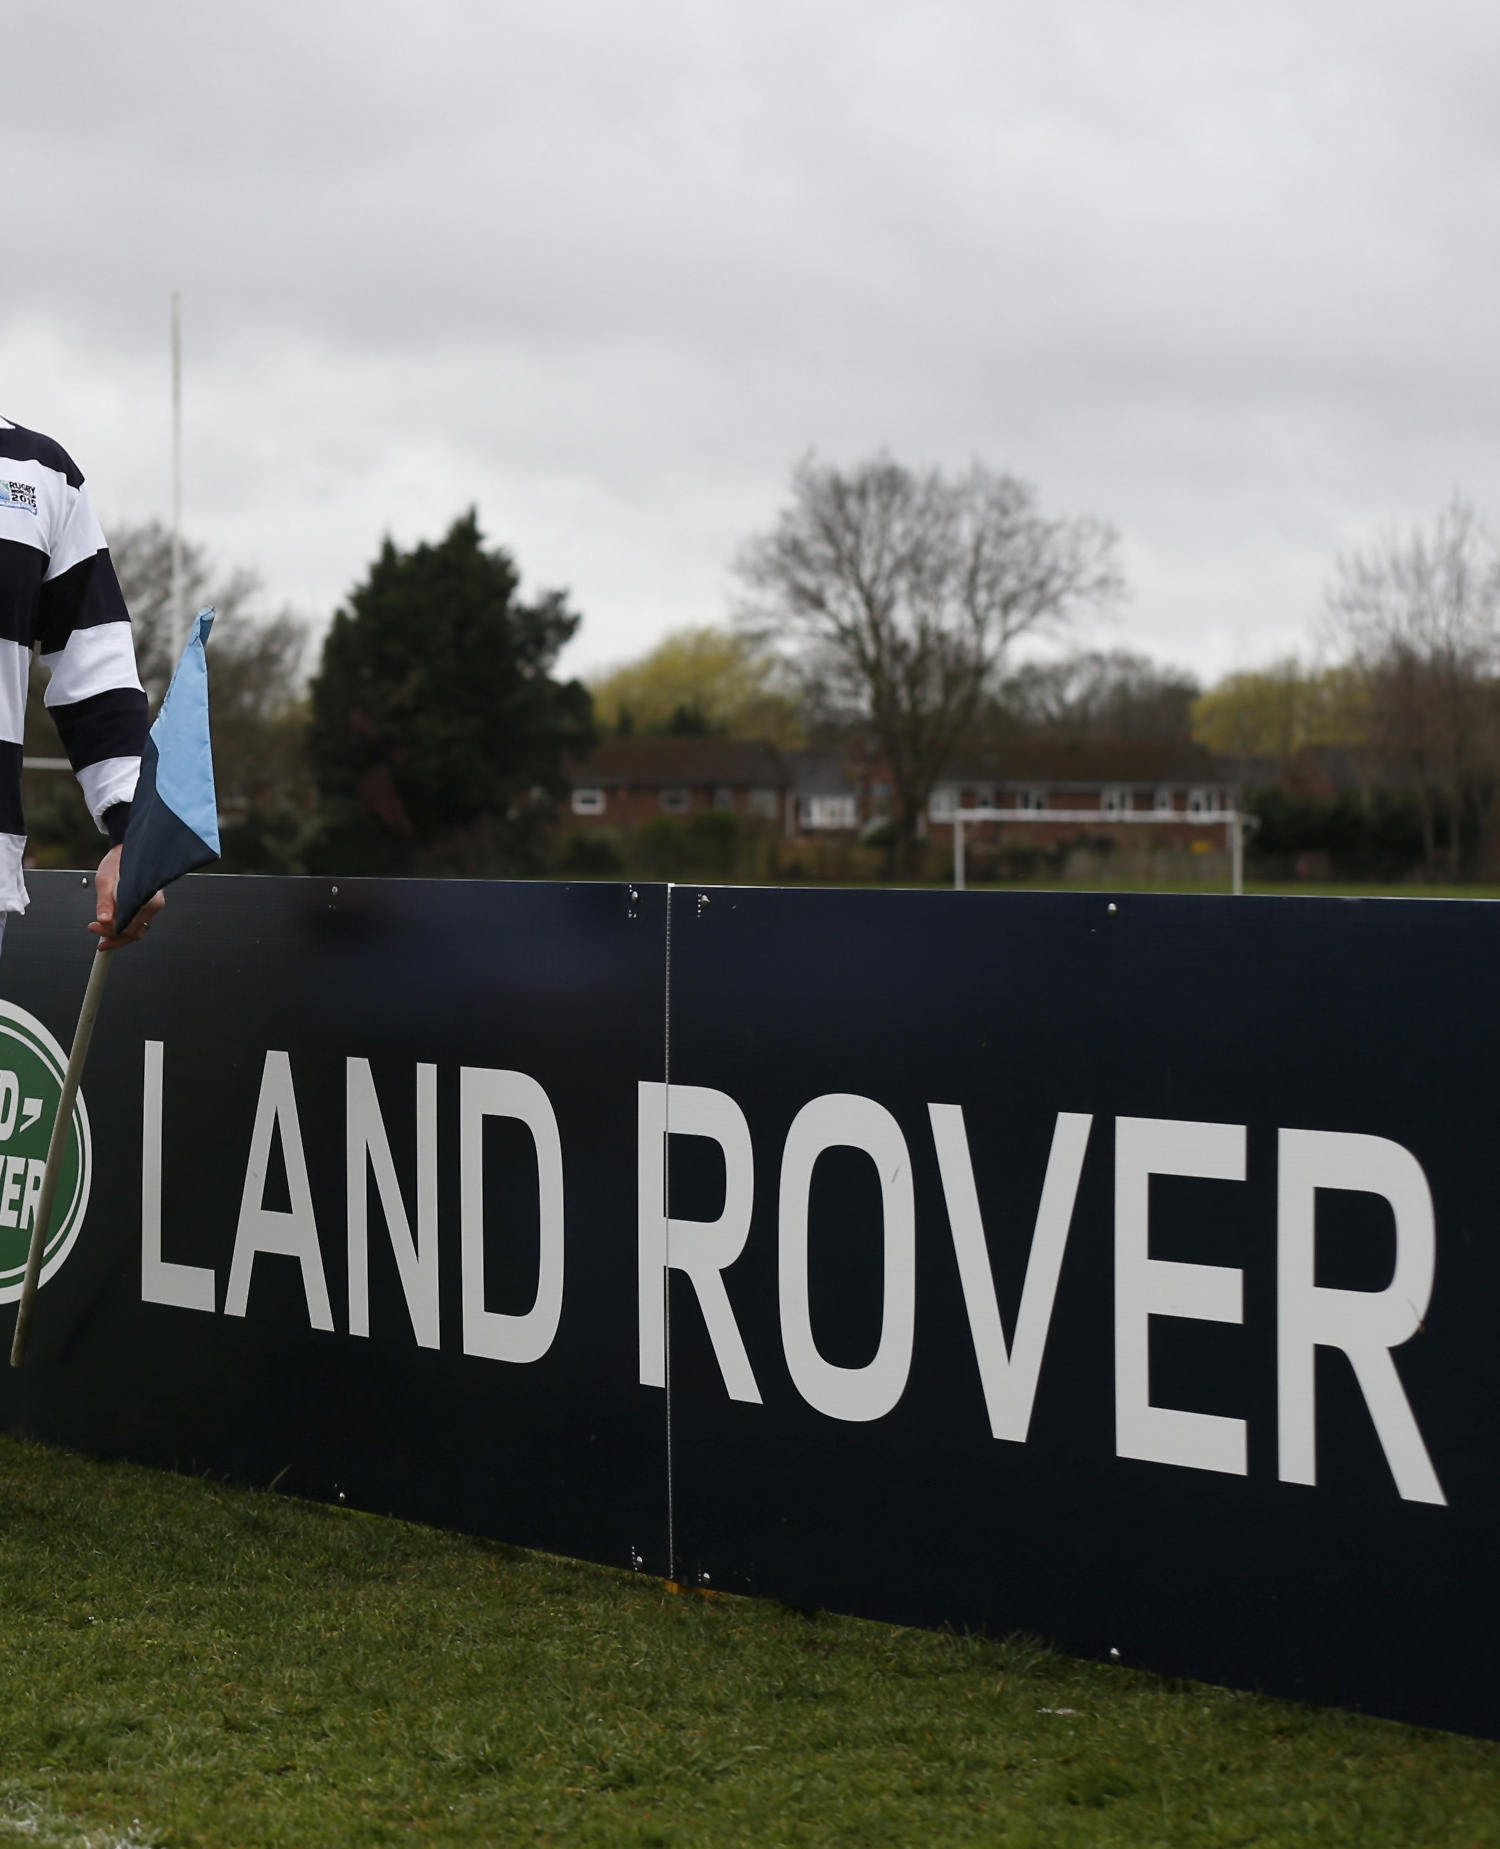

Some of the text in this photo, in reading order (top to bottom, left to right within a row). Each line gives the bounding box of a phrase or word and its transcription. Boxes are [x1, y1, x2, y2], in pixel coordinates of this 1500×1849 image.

[9, 481, 36, 494] RUGBY
[11, 494, 37, 507] 2015
[141, 1040, 1449, 1507] LAND ROVER
